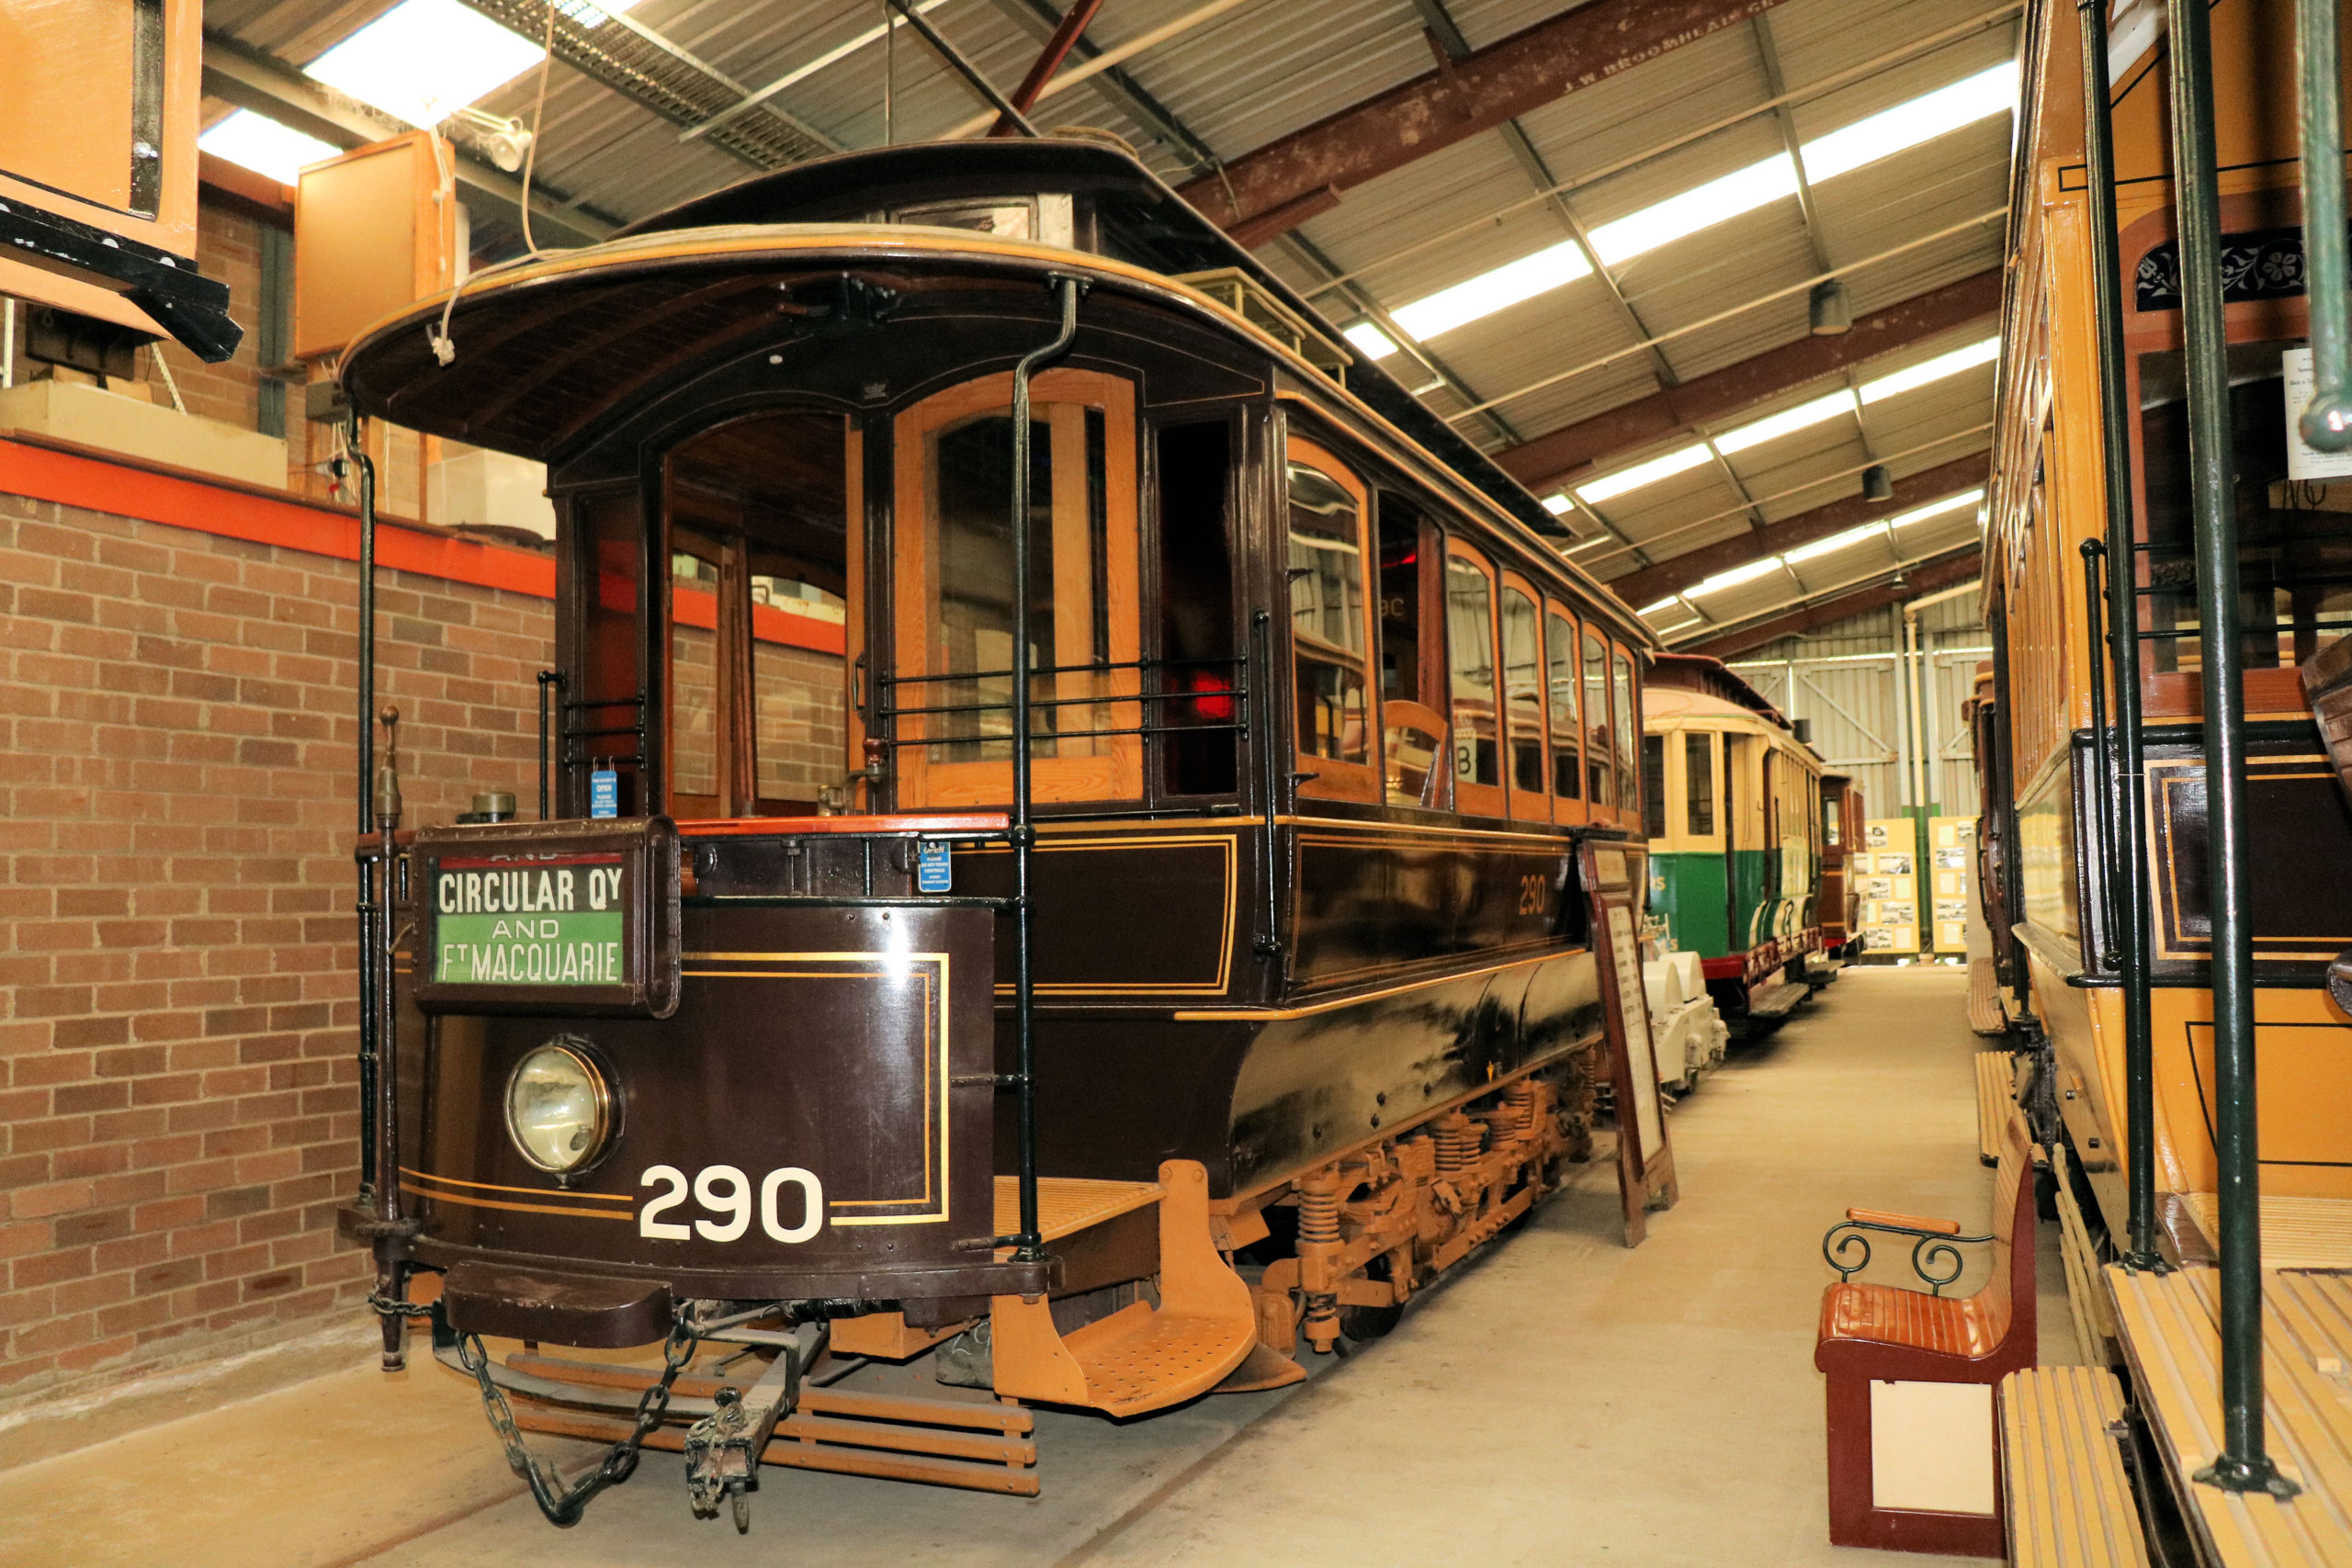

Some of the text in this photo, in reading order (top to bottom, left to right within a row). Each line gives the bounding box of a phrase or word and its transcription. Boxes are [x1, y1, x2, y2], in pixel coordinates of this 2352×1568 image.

[439, 868, 623, 913] CIRCULAR QY
[1519, 874, 1545, 916] 290
[492, 919, 560, 939] AND
[470, 942, 618, 981] MACQUARIE
[640, 1164, 823, 1244] 290
